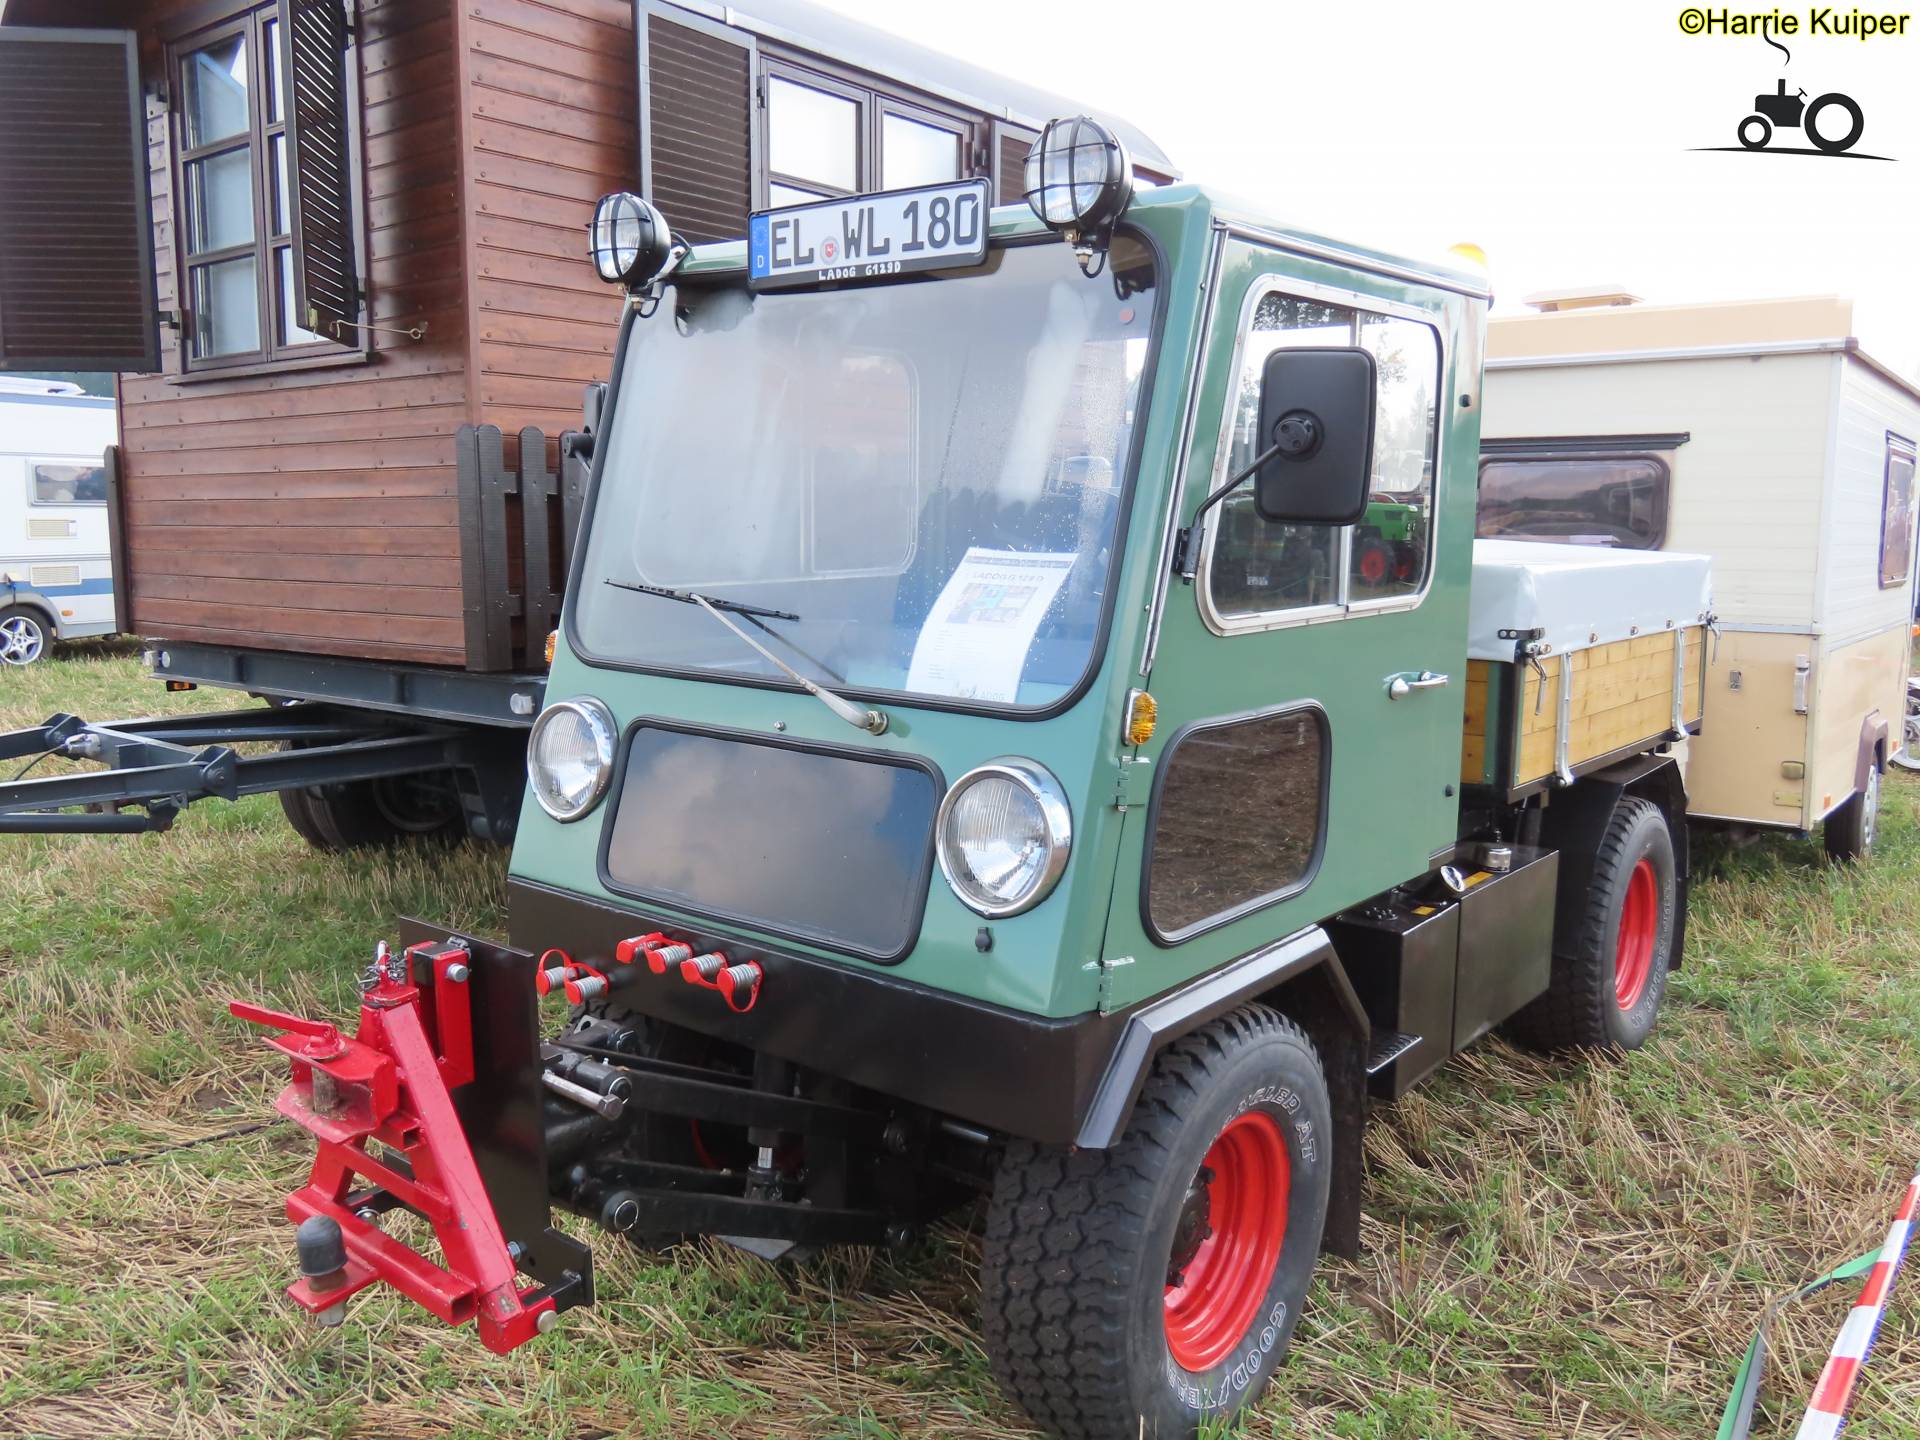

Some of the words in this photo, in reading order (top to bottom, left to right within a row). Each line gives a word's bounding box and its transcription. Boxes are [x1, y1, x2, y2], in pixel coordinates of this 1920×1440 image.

[771, 217, 815, 270] EL
[842, 206, 891, 260] WL
[901, 192, 979, 253] 180
[756, 254, 765, 270] D
[818, 266, 856, 281] LADOG
